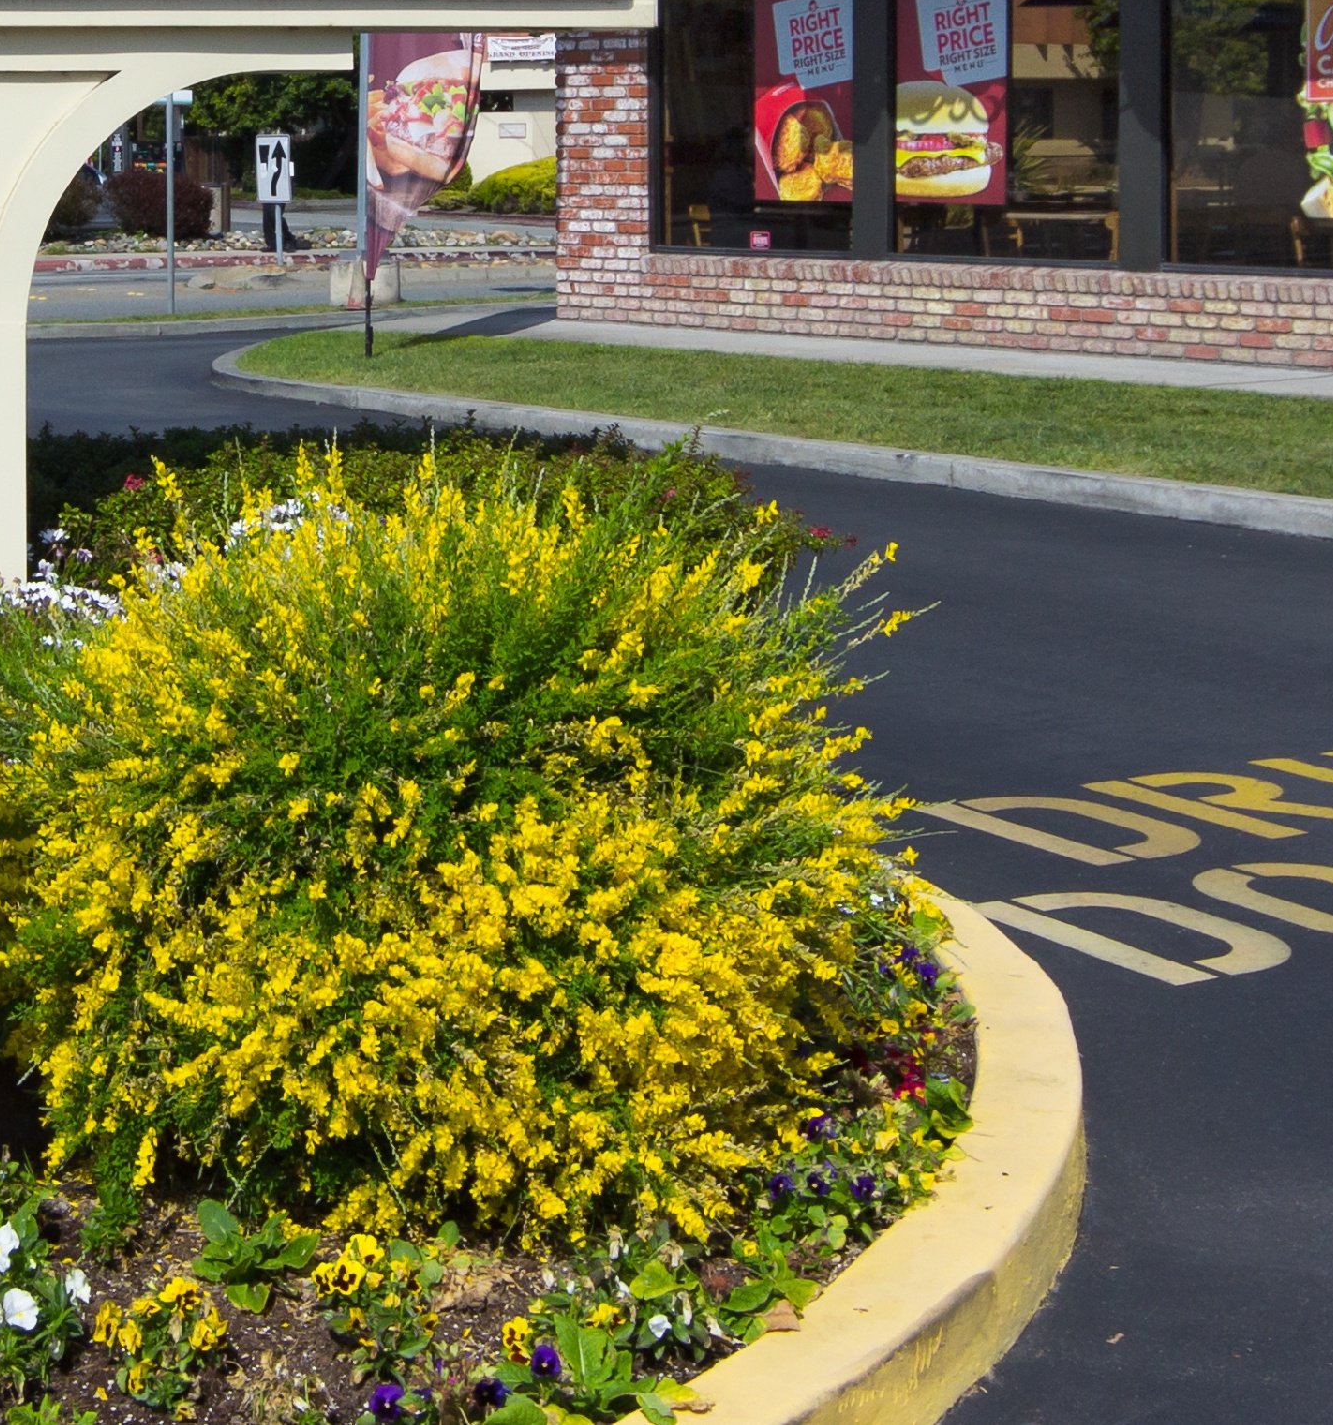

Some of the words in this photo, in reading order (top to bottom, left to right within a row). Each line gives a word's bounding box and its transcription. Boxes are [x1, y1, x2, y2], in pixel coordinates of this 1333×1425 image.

[789, 7, 841, 36] RIGHT
[934, 2, 991, 32] RIGHT
[792, 28, 844, 58] PRICE
[936, 23, 996, 53] PRICE
[793, 53, 823, 69] RIGHT
[824, 49, 846, 64] SIZE
[939, 49, 973, 65] RIGHT
[973, 44, 997, 60] SIZE
[954, 60, 985, 73] MENU
[807, 64, 835, 76] MENU
